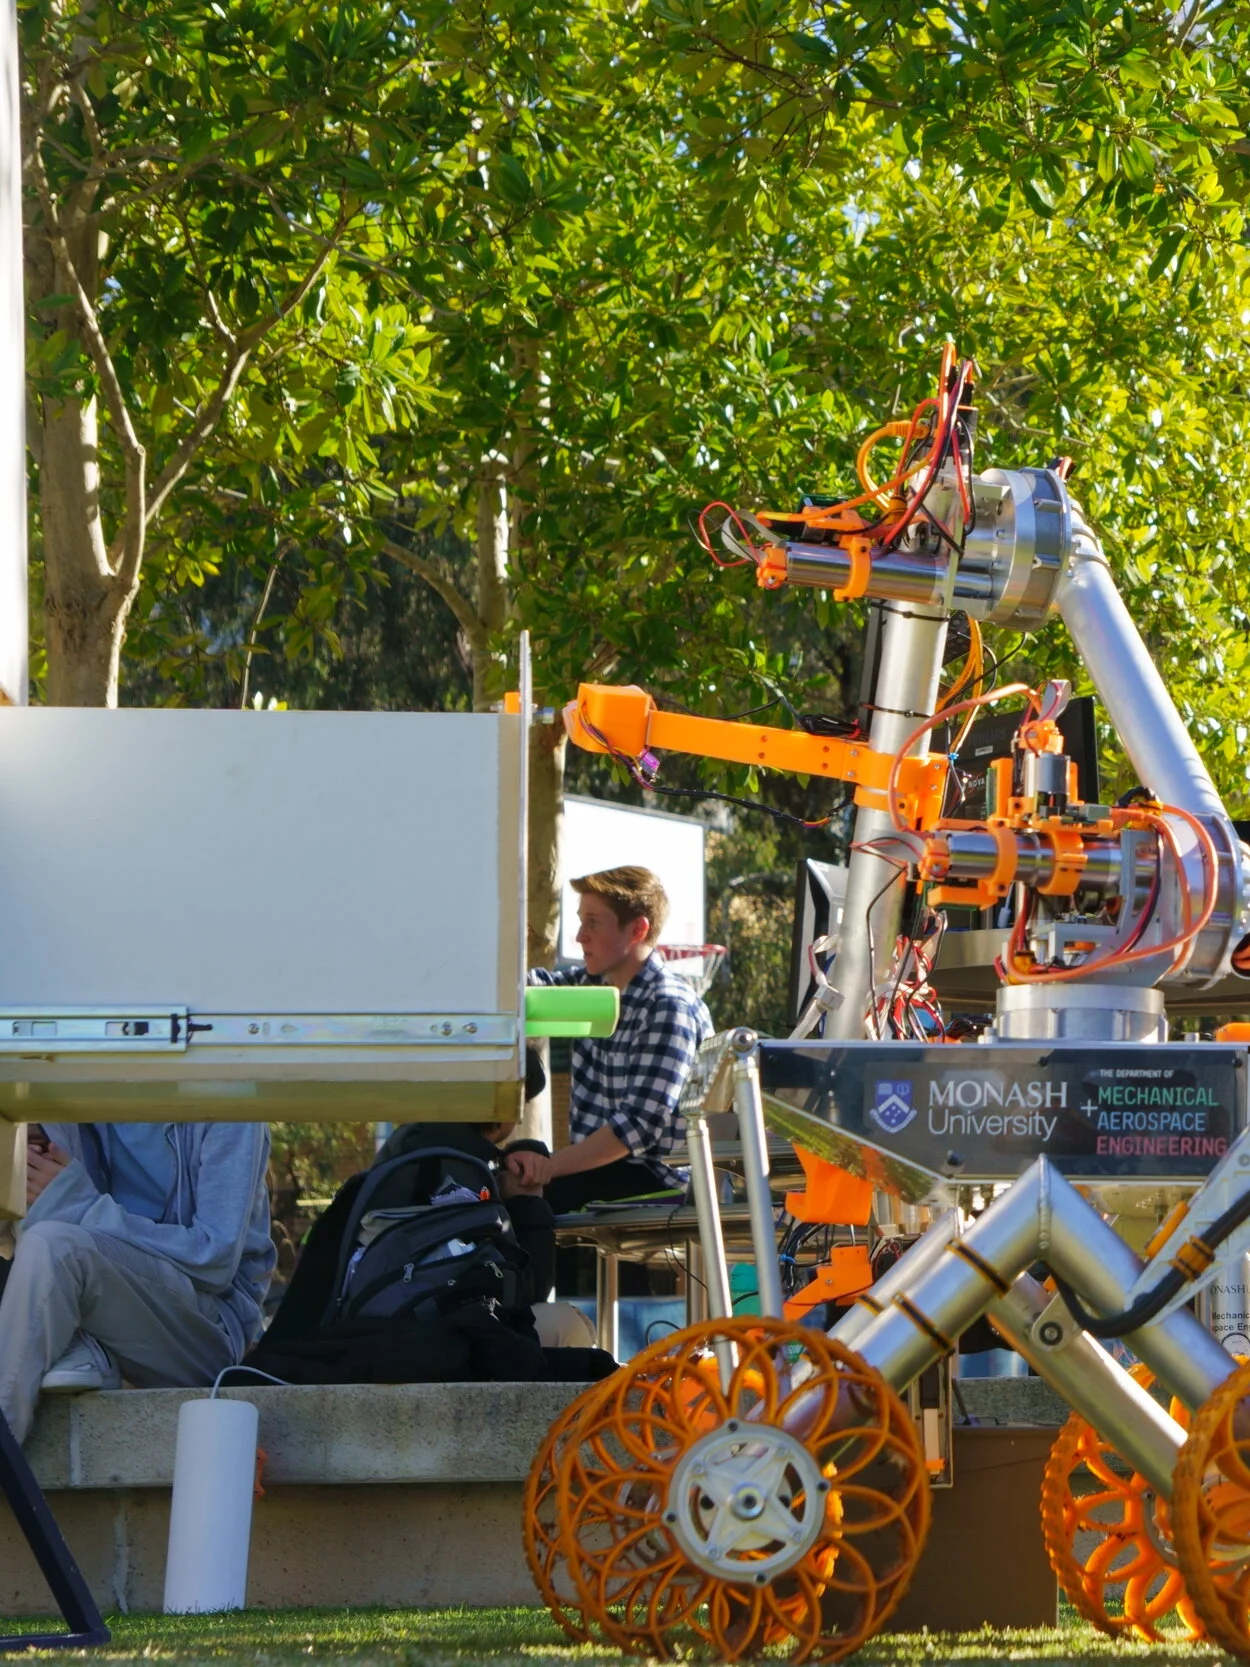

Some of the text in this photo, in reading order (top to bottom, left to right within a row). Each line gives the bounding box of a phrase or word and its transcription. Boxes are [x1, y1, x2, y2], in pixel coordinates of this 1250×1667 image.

[968, 777, 985, 787] NOVA
[1100, 1069, 1174, 1078] THE DEPARTMENT OF
[929, 1080, 1068, 1108] MONASH
[1098, 1086, 1219, 1106] MECHANICAL
[928, 1108, 1058, 1141] University
[1097, 1111, 1206, 1131] AEROSPACE
[1096, 1136, 1228, 1156] ENGINEERING
